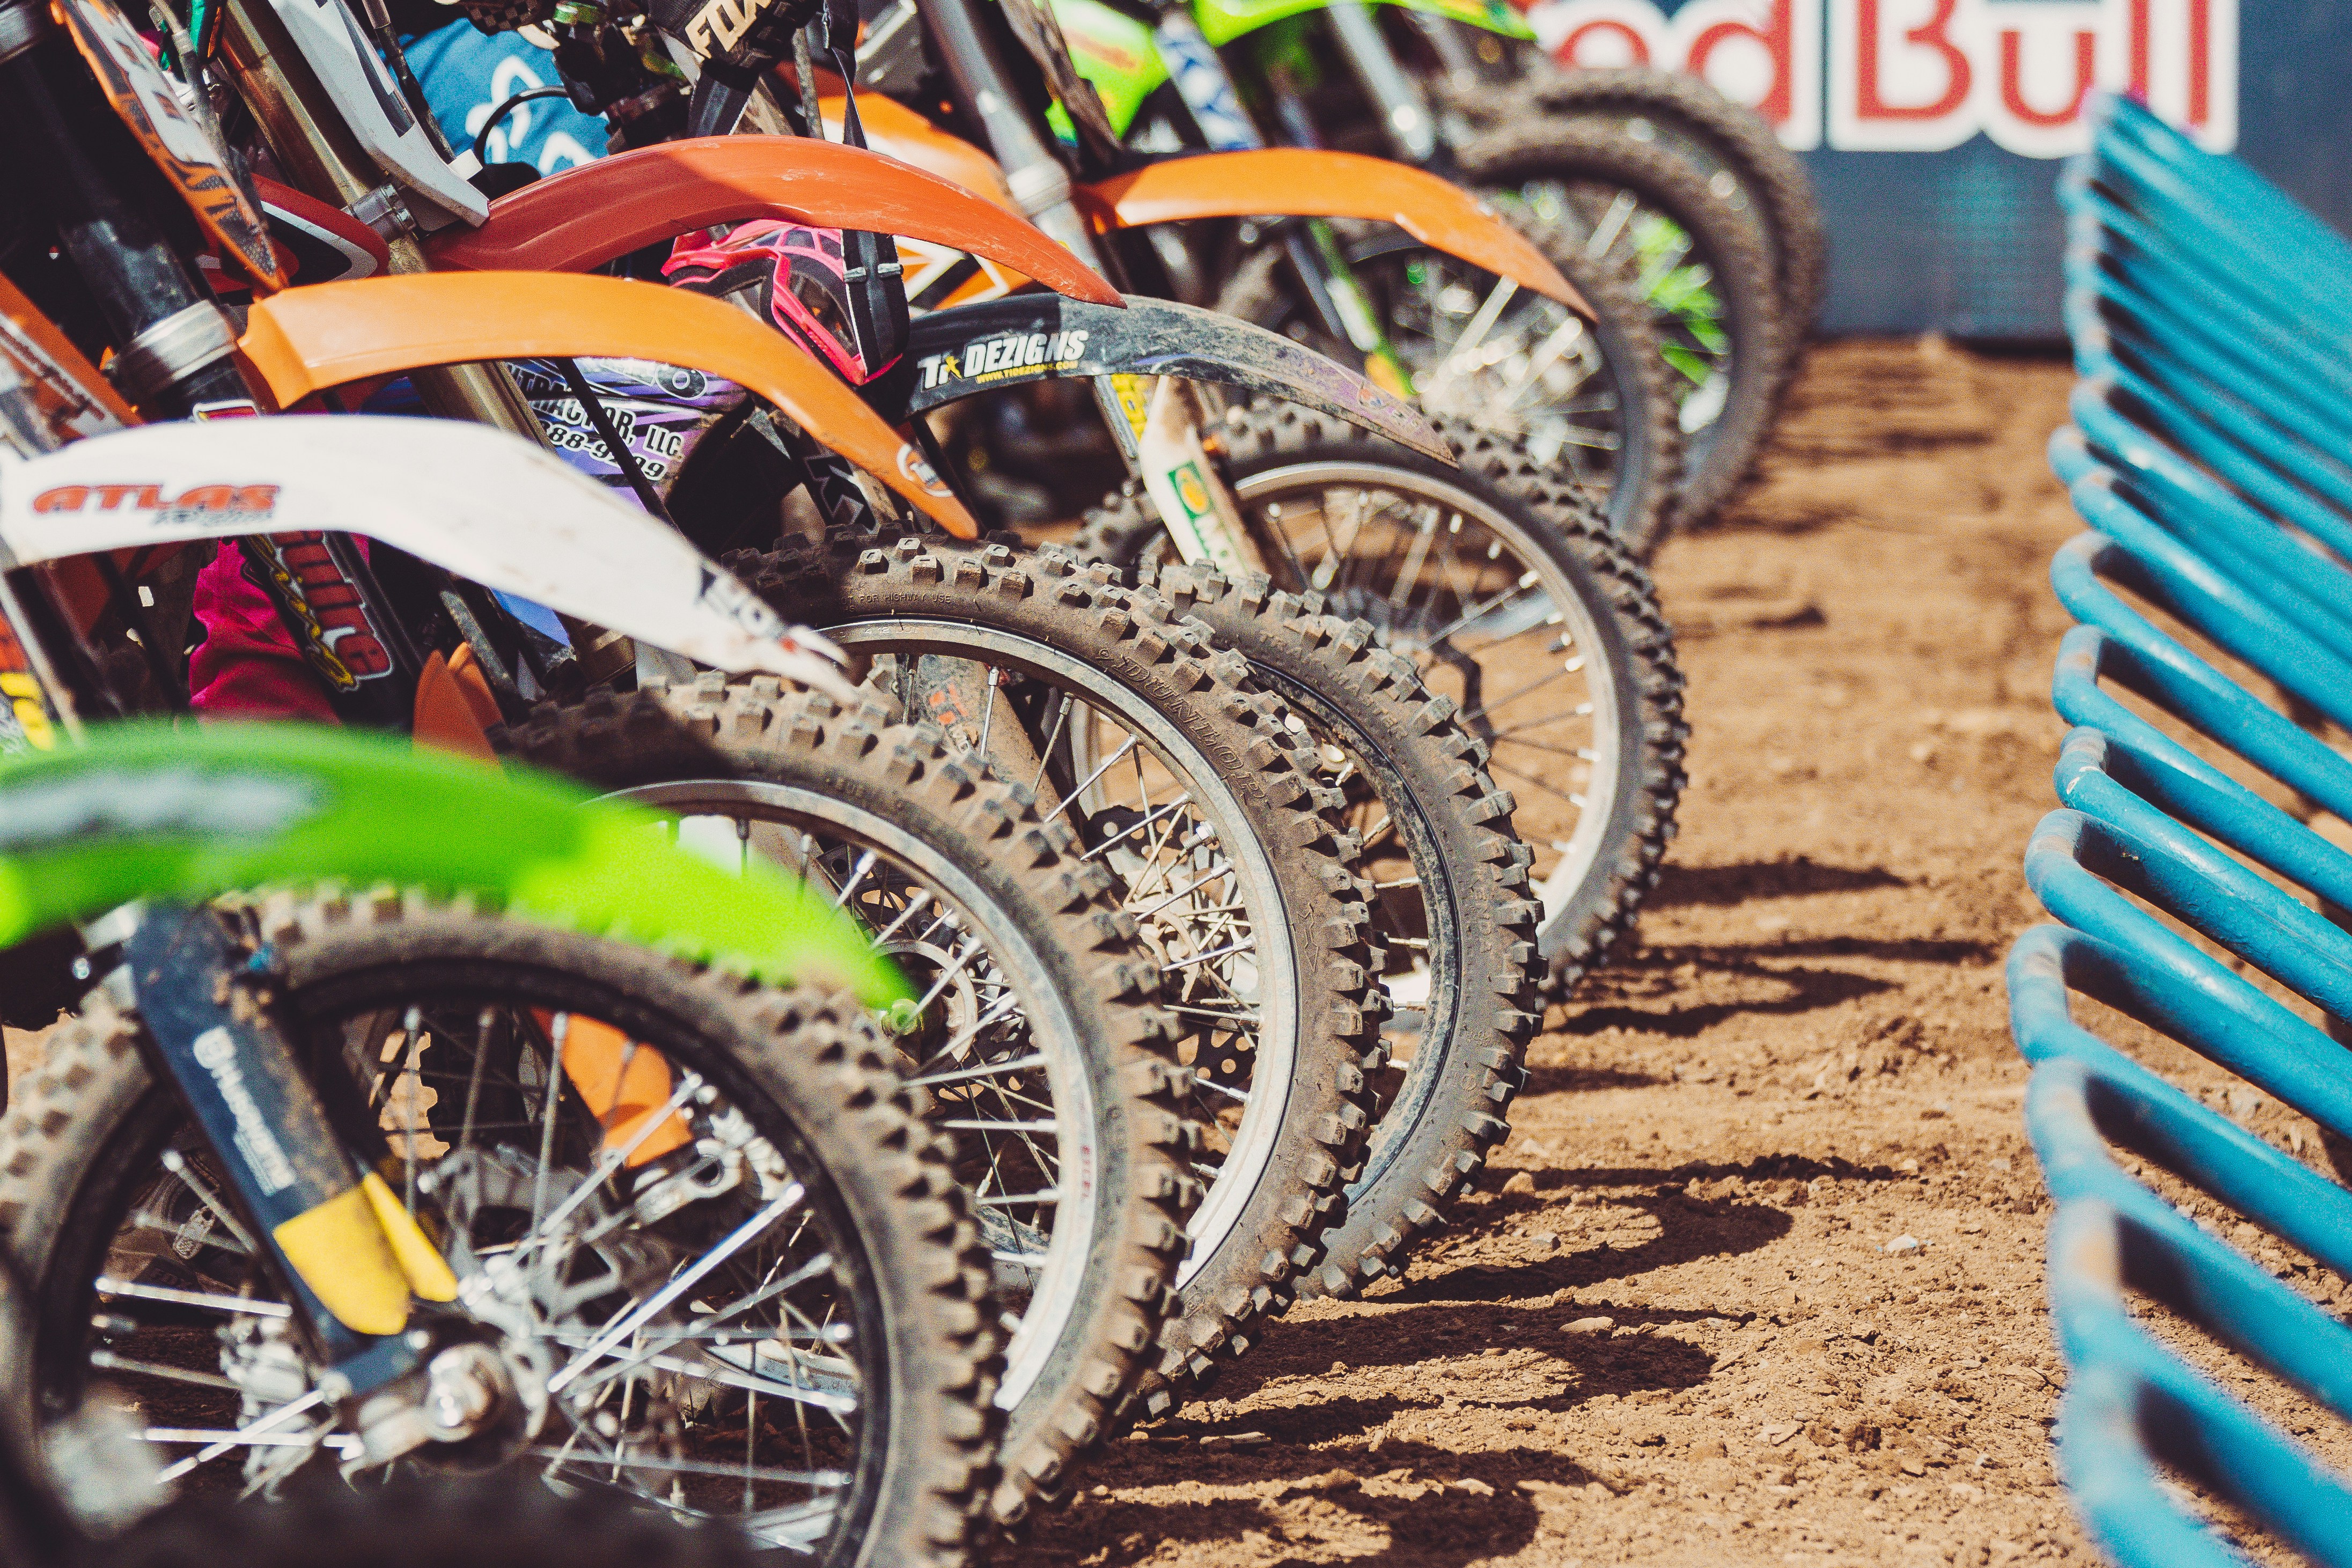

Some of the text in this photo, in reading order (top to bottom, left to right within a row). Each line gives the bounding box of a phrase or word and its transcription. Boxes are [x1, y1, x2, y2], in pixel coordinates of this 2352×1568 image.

[964, 330, 1089, 378] DEZIGNS
[33, 483, 281, 515] ATLAS
[859, 594, 879, 603] FOR
[884, 592, 927, 602] HIGHWAY
[931, 593, 952, 604] USE
[1112, 654, 1266, 799] DUNLOP
